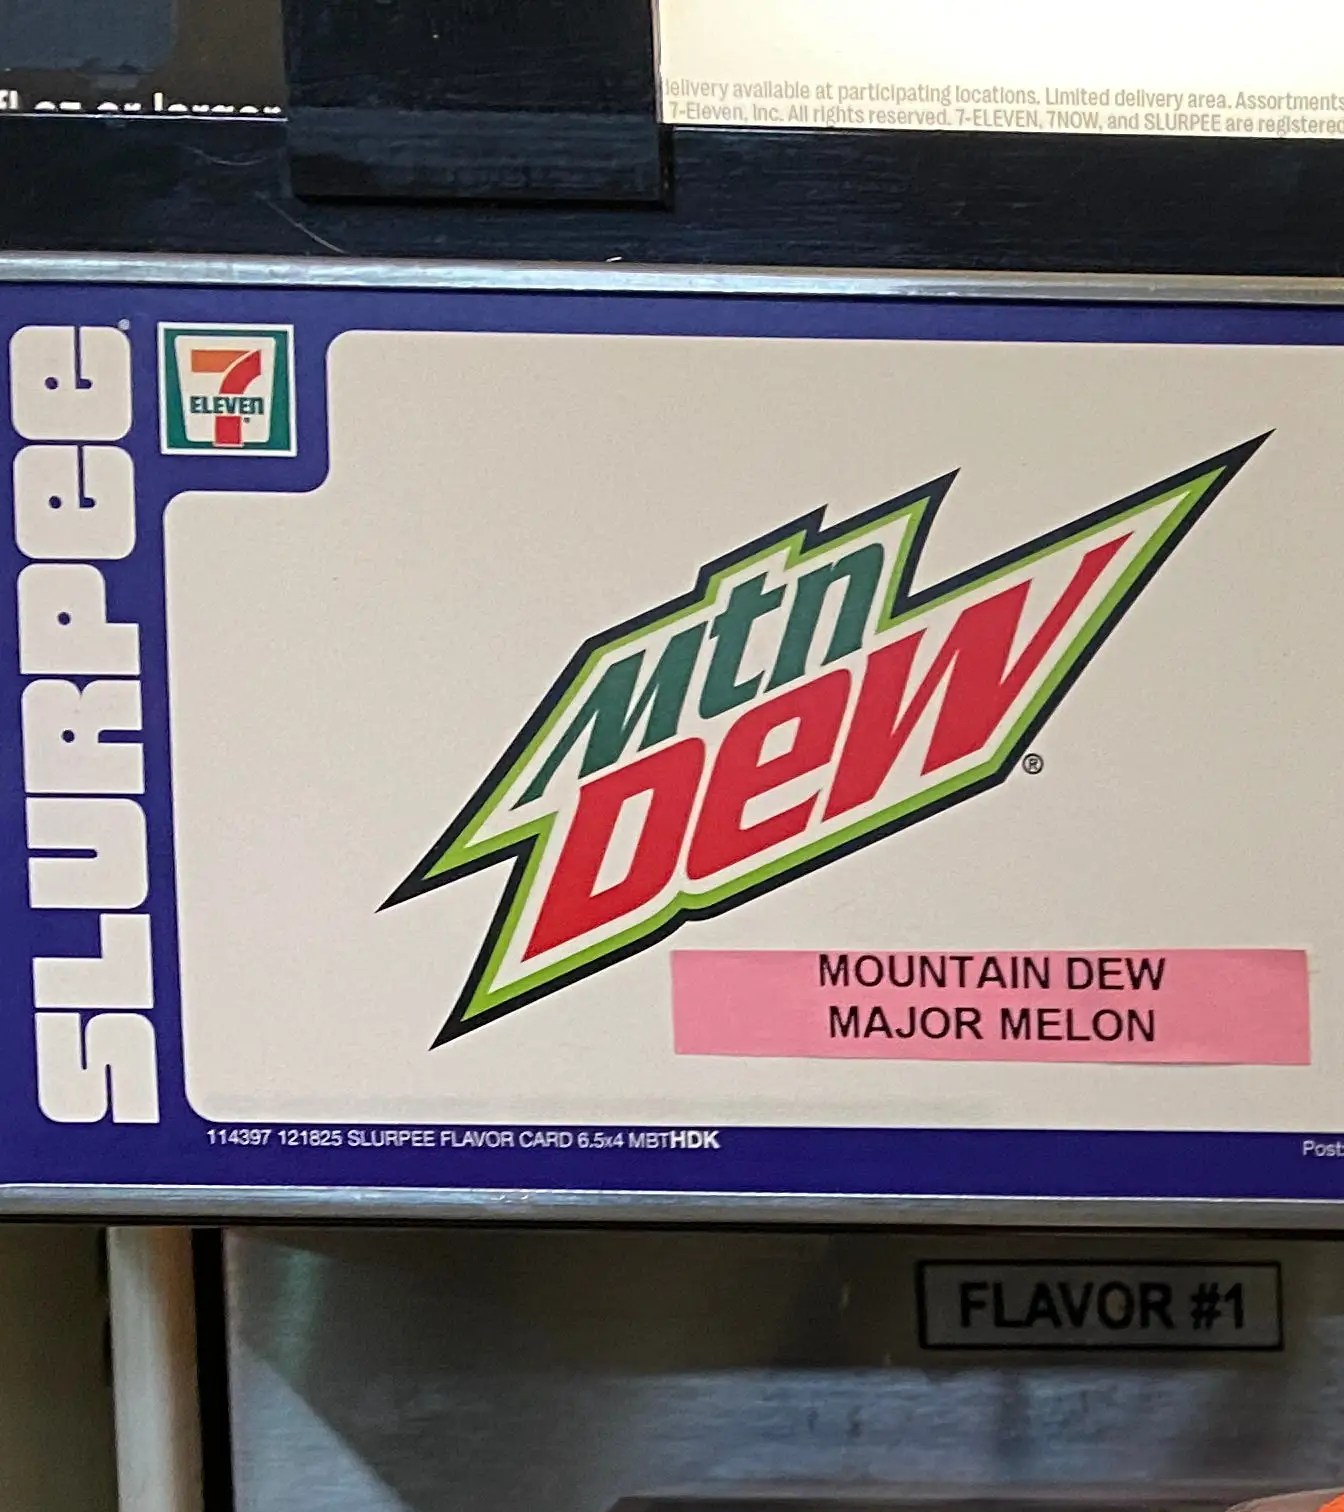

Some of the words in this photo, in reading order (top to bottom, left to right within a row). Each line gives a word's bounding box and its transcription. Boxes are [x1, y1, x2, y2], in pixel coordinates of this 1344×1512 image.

[732, 80, 810, 99] available
[816, 83, 834, 99] at
[838, 83, 951, 105] participating
[955, 84, 1040, 104] locations.
[1045, 87, 1110, 106] Limited
[1114, 89, 1184, 110] delivery
[1187, 93, 1231, 109] area.
[752, 104, 784, 122] Inc.
[788, 105, 808, 123] All
[812, 105, 865, 127] rights
[869, 106, 952, 125] reserved.
[955, 109, 1044, 130] 7-ELEVEN,
[1108, 113, 1139, 131] and
[1144, 113, 1221, 132] SLURPEE
[1225, 118, 1254, 132] are
[818, 954, 1051, 991] MOUNTAIN
[1066, 956, 1166, 991] DEW
[829, 1005, 983, 1041] MAJOR
[999, 1008, 1156, 1043] MELON
[206, 1129, 272, 1146] 114397
[277, 1129, 342, 1146] 121825
[347, 1129, 435, 1147] SLURPEE
[440, 1130, 515, 1148] FLAVOR
[519, 1131, 573, 1148] CARD
[577, 1131, 625, 1149] 6.5x4
[958, 1281, 1175, 1330] FLAVOR
[1189, 1281, 1244, 1330] #1
